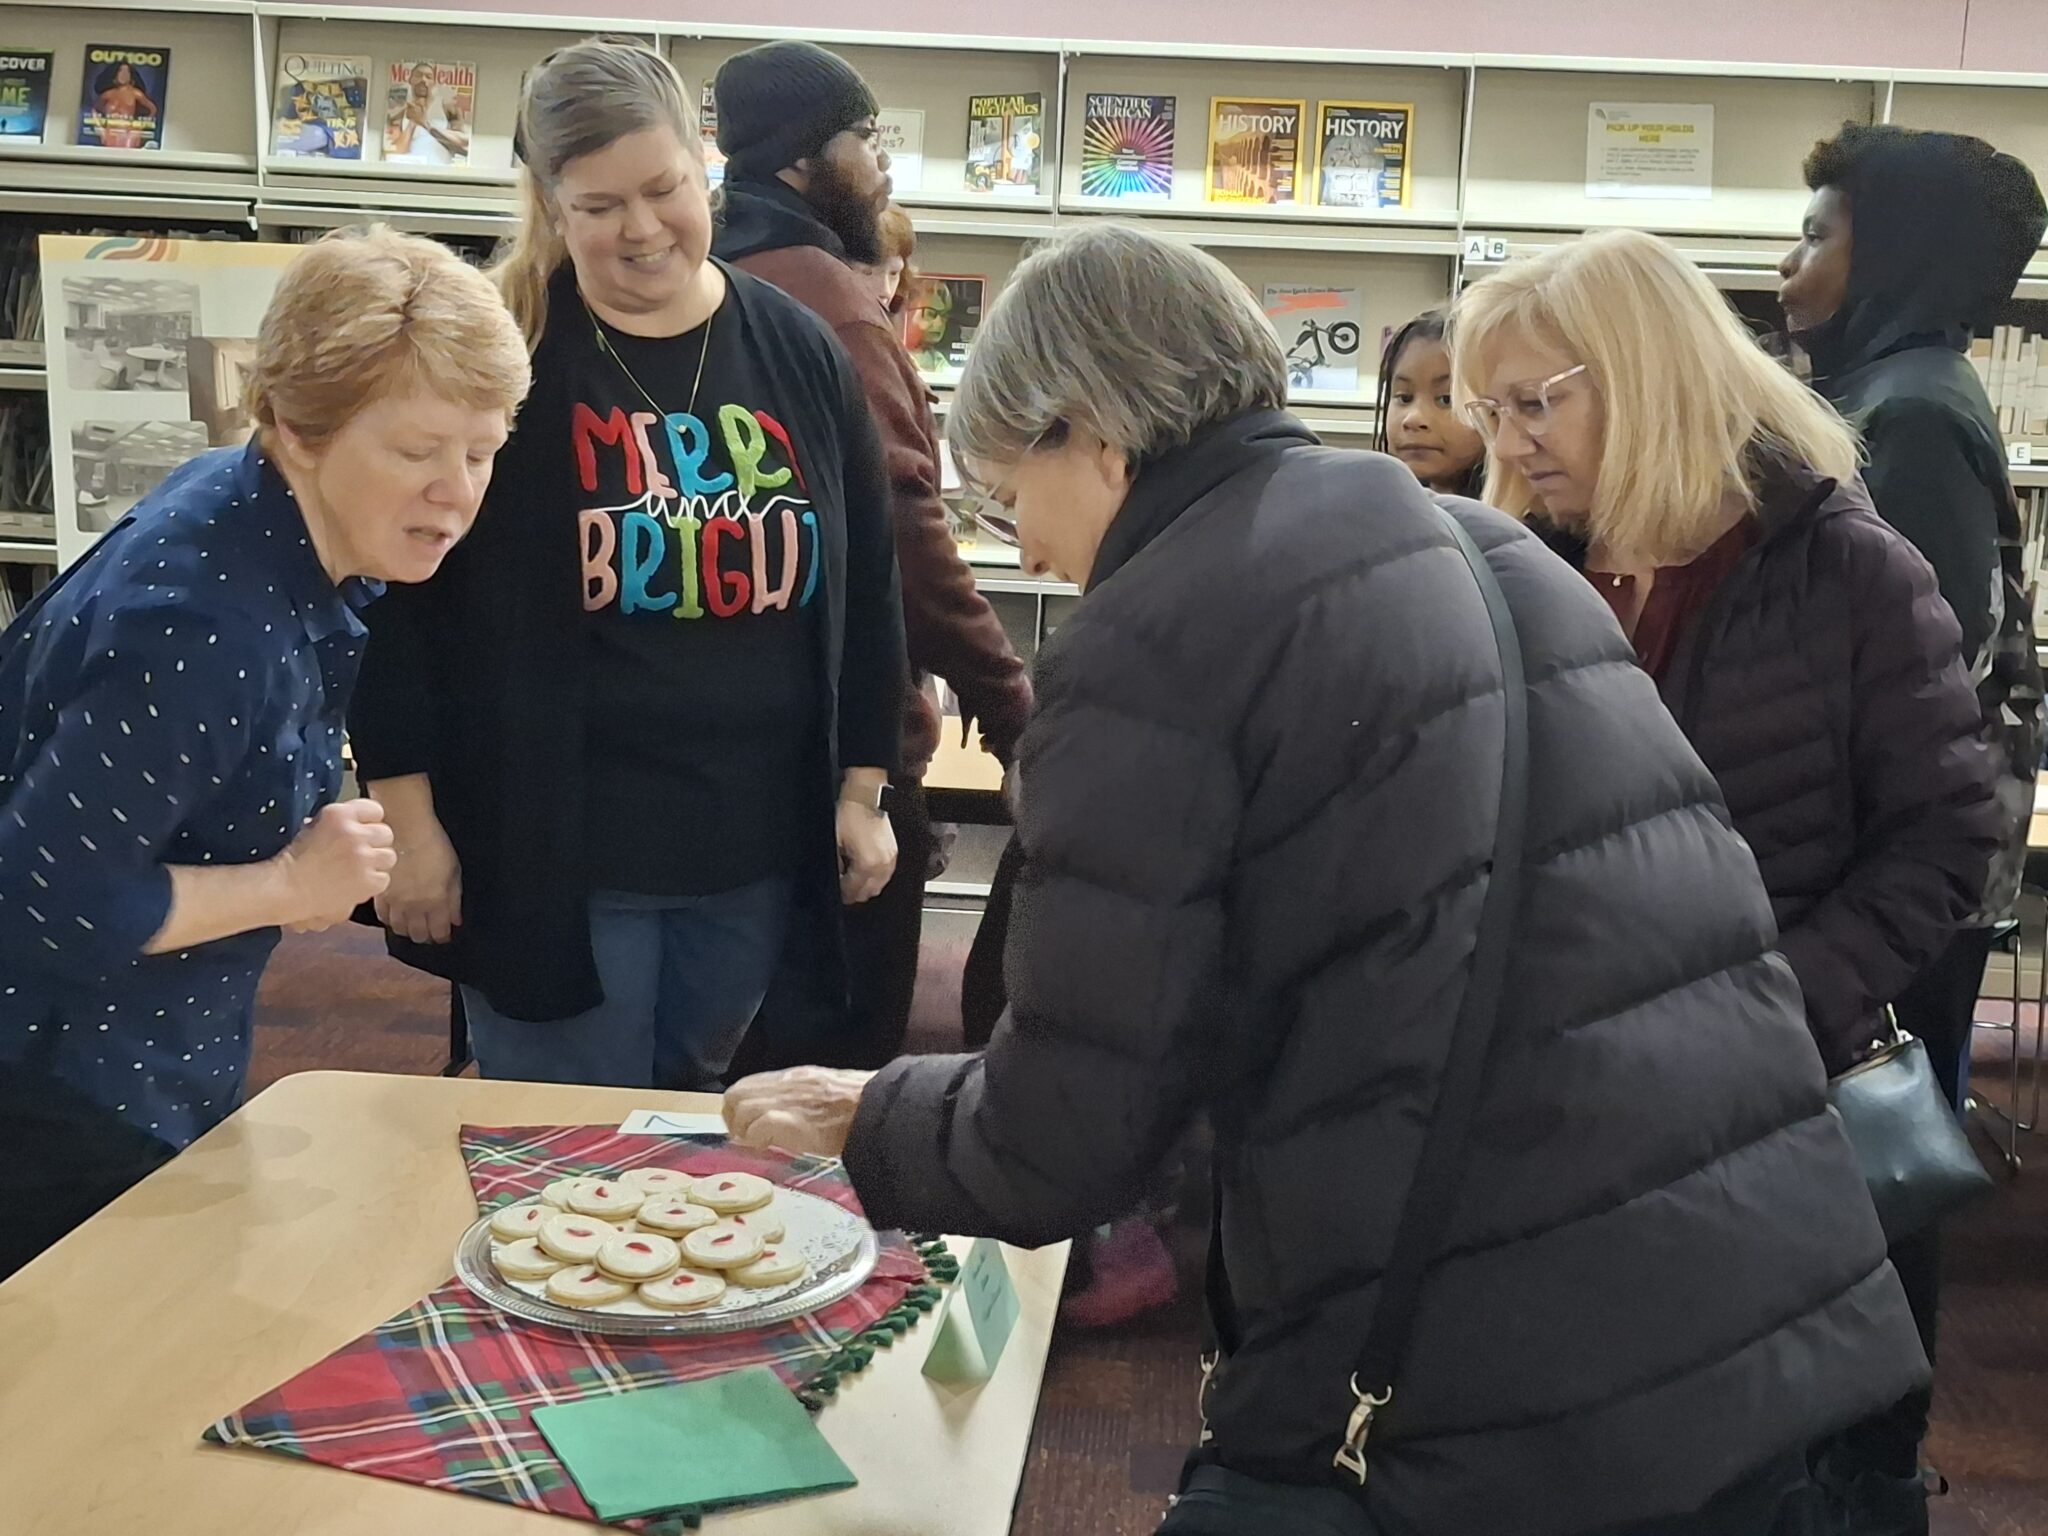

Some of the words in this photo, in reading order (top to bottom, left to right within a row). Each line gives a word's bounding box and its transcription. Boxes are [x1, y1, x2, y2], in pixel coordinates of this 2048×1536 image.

[91, 50, 162, 67] OUT100
[1087, 95, 1152, 108] SCIENTIFIC
[1087, 106, 1152, 119] AMERICAN
[879, 124, 902, 134] ore
[1219, 114, 1296, 134] HISTORY
[1325, 118, 1404, 139] HISTORY
[1469, 241, 1481, 254] A
[1493, 242, 1504, 255] B
[2016, 446, 2026, 459] E
